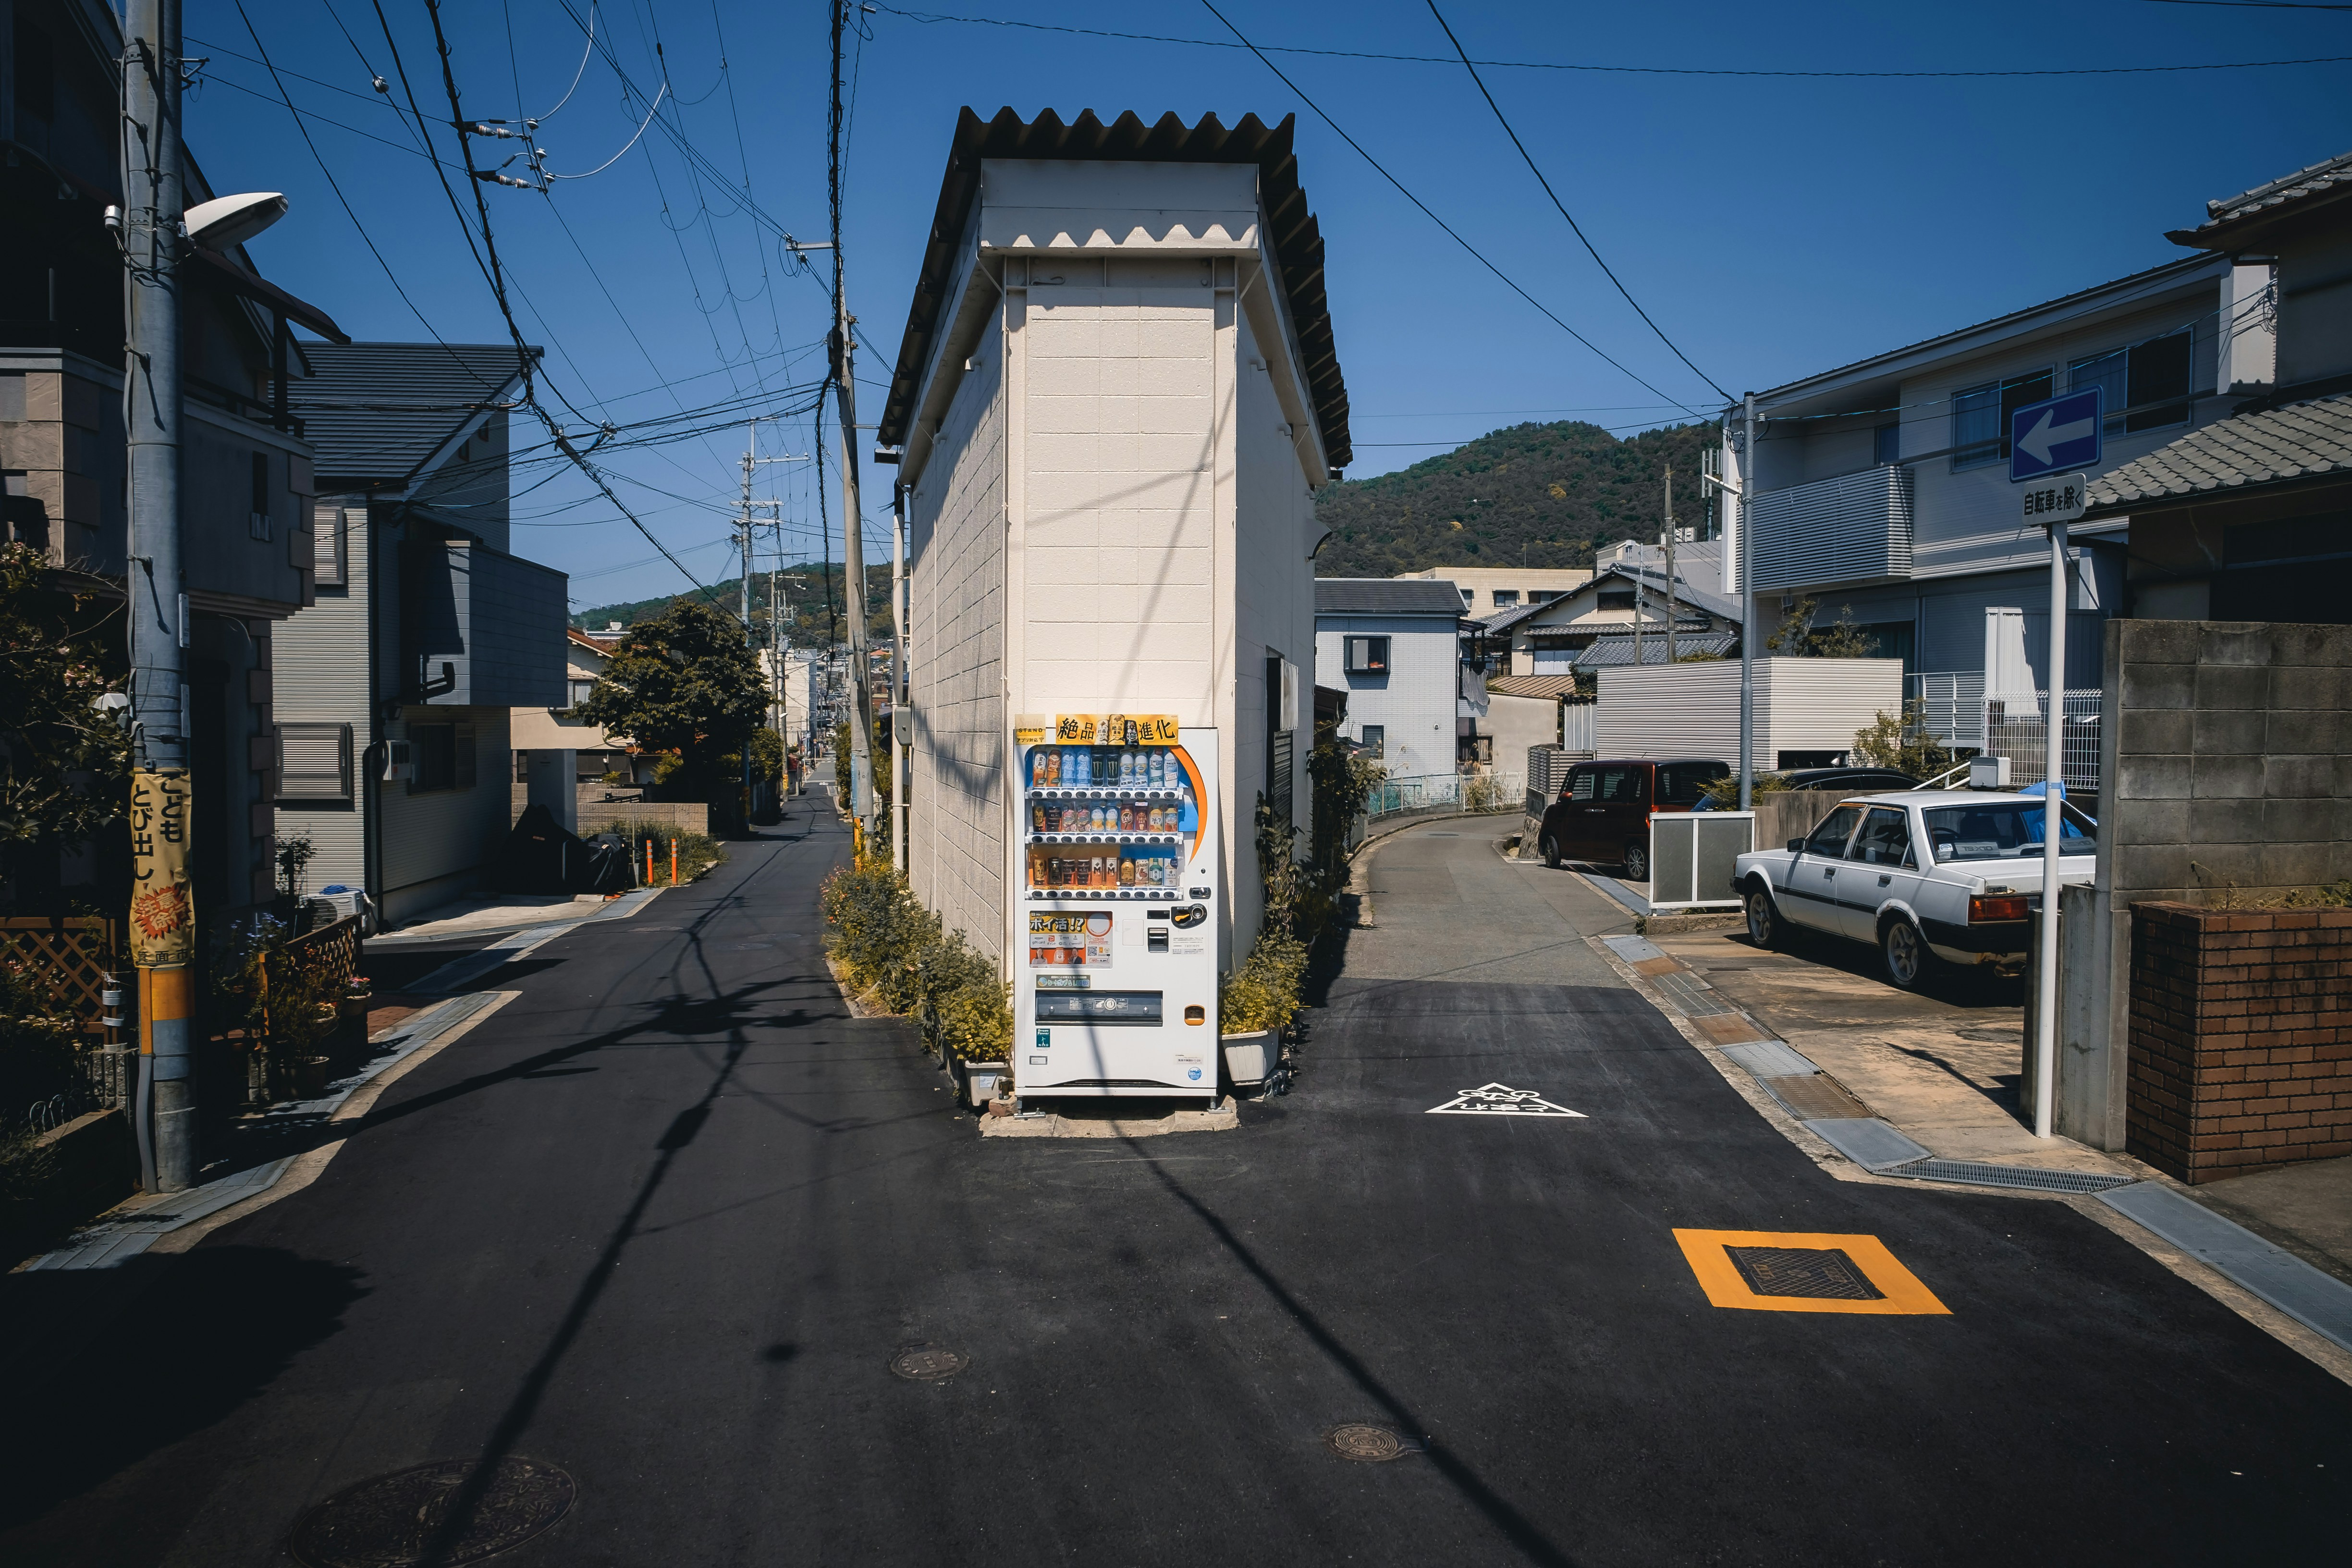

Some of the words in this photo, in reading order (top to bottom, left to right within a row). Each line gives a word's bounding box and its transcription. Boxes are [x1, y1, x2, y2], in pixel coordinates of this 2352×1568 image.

[2024, 485, 2082, 516] 自転車を除く
[1056, 717, 1094, 740] 絶品
[1139, 719, 1176, 741] 進化
[160, 773, 184, 843] こども
[133, 784, 154, 881] とび出し
[138, 891, 178, 918] 注意
[149, 903, 187, 931] 徐行
[1030, 916, 1085, 932] ポイ活!?
[1456, 1103, 1549, 1112] とまれ
